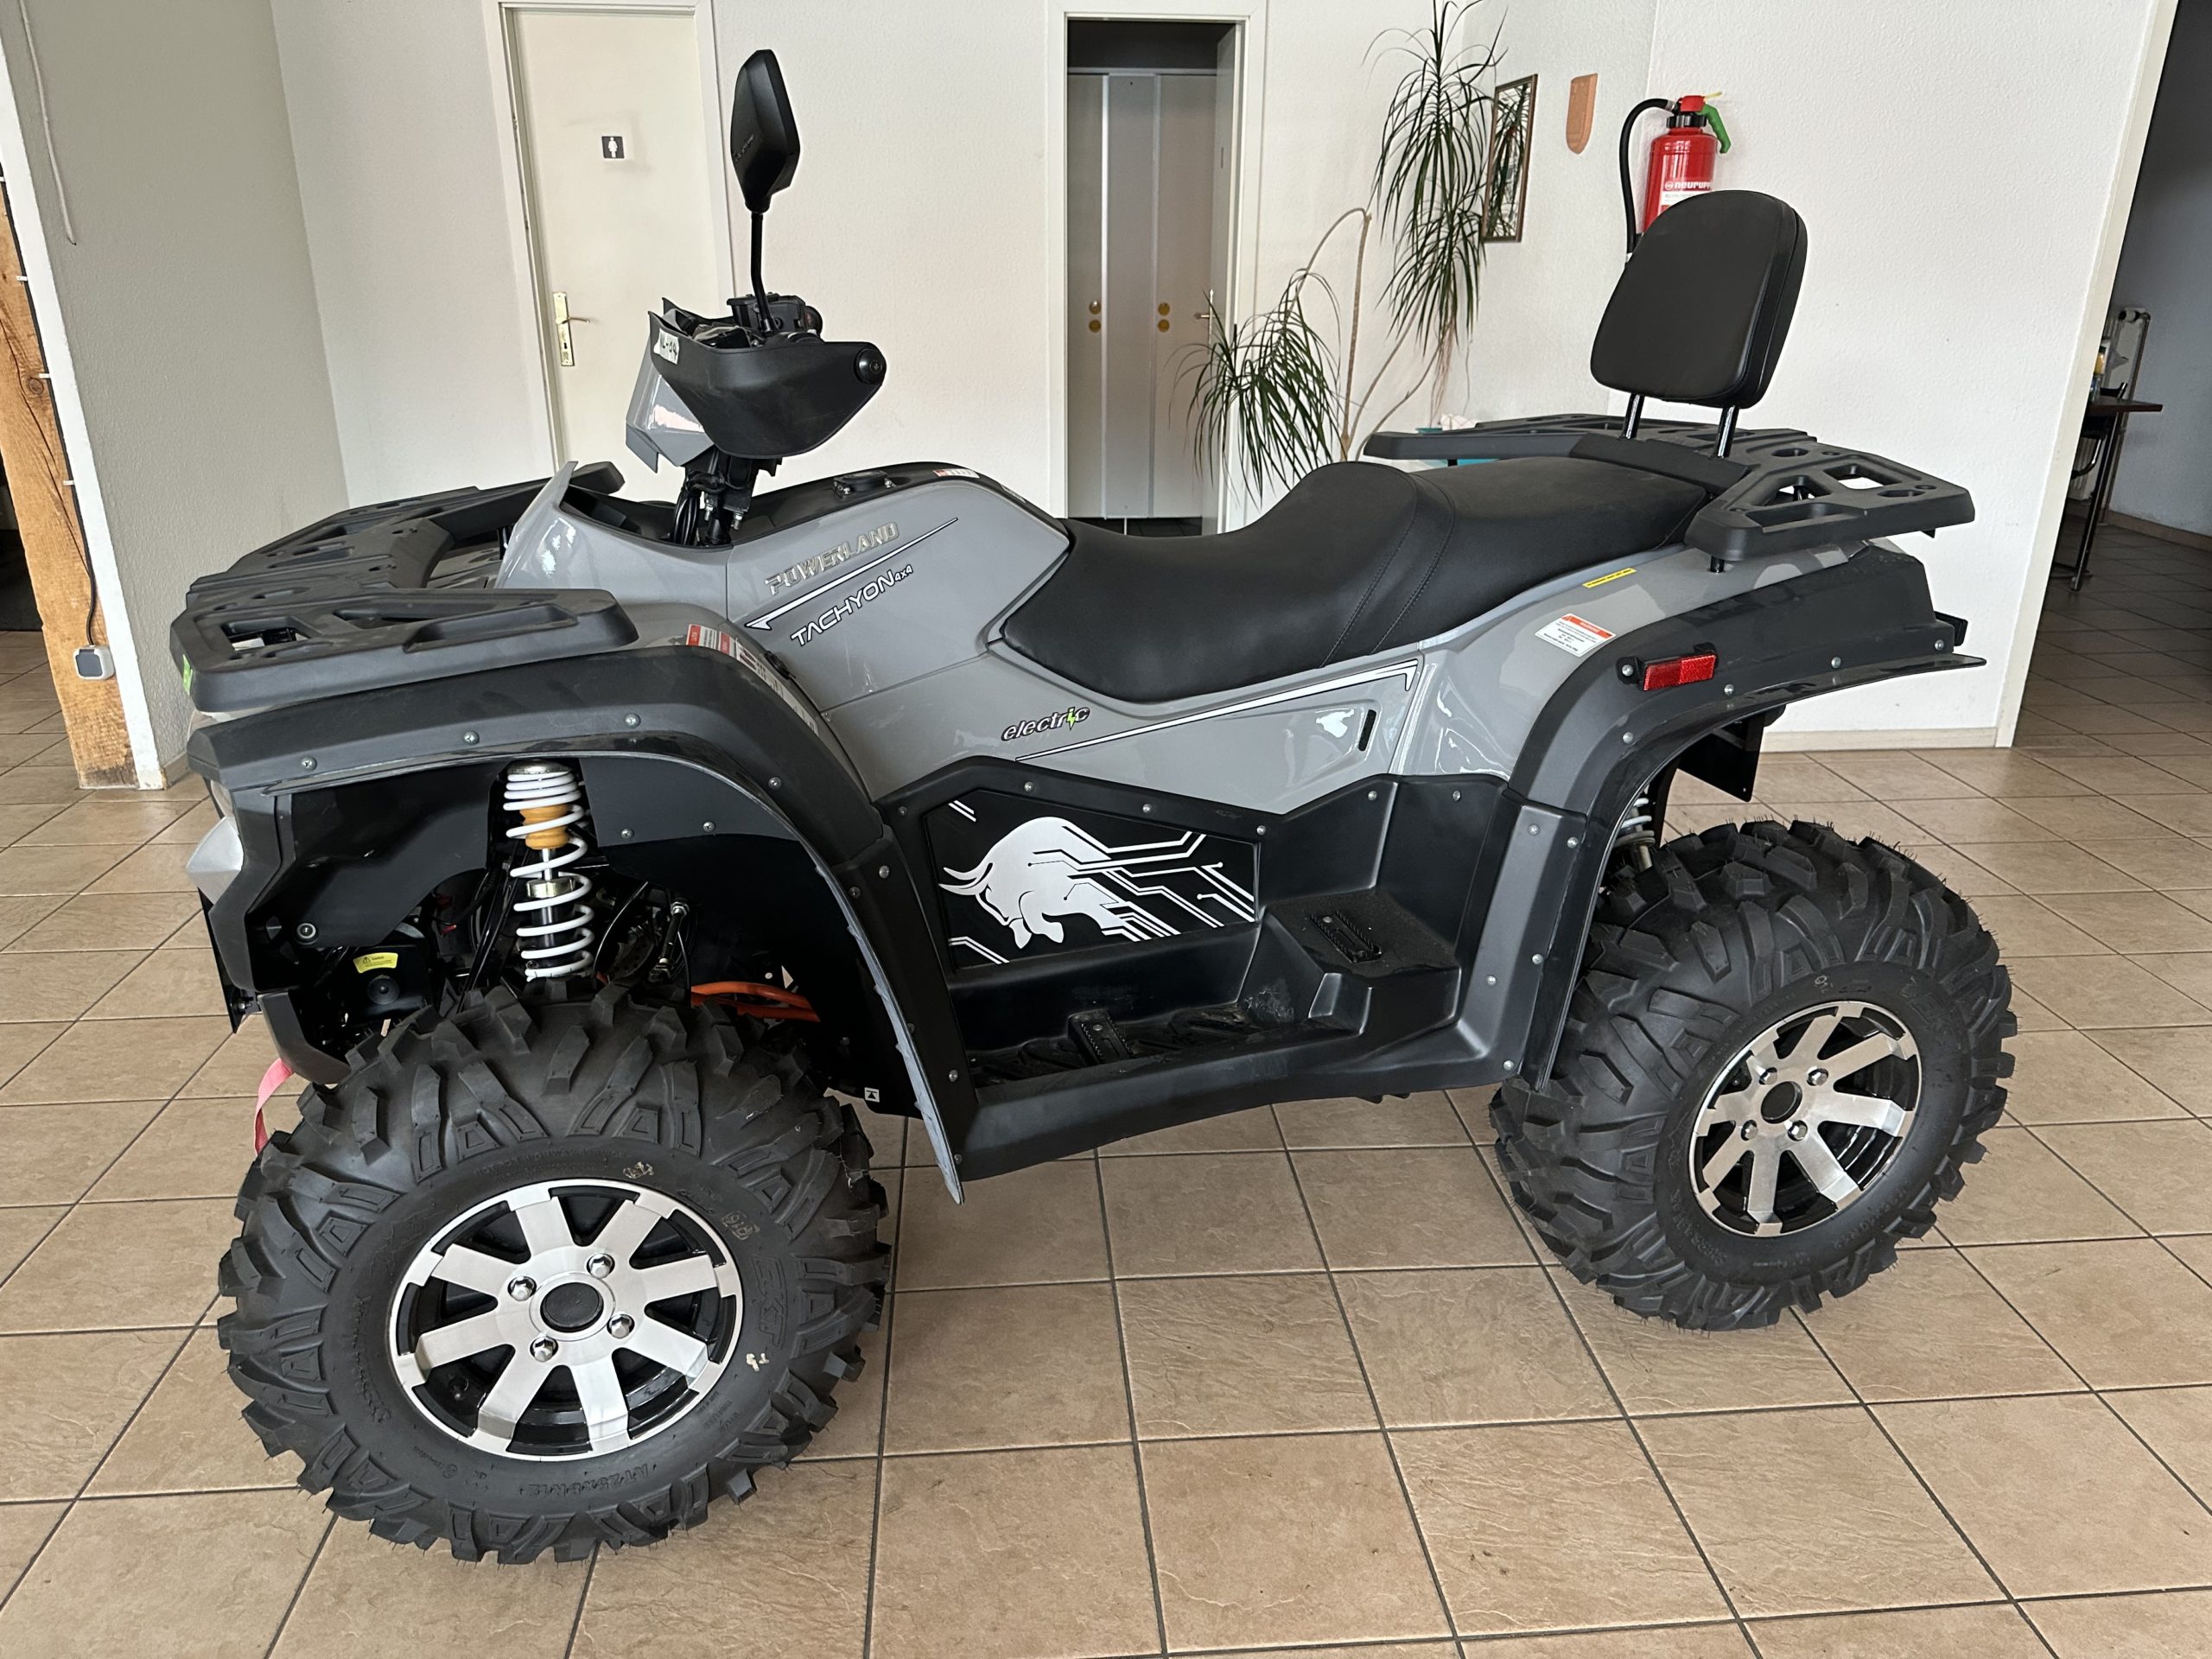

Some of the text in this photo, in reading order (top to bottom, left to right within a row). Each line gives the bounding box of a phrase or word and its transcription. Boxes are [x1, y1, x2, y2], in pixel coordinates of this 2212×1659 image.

[765, 521, 899, 595] POWERLAND
[791, 569, 896, 647] TACHYON
[1001, 706, 1090, 741] electric
